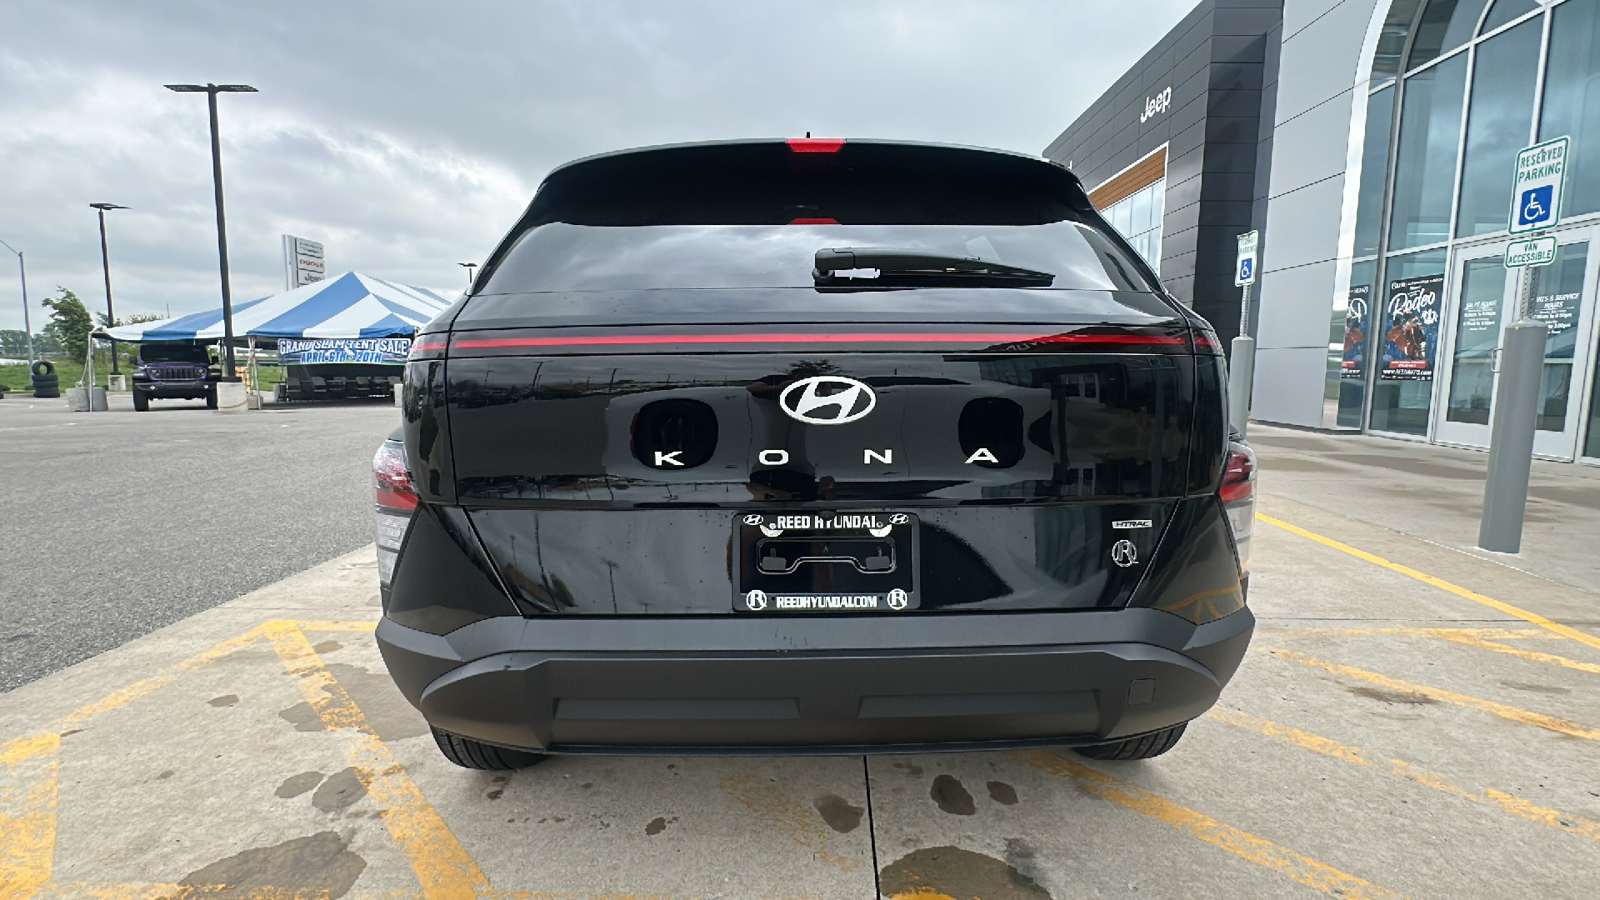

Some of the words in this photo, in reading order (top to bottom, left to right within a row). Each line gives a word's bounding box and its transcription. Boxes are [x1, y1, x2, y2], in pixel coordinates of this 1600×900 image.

[1140, 86, 1171, 123] Jeep
[1520, 146, 1563, 169] RESERVED
[1518, 161, 1562, 182] PARKING
[1524, 242, 1538, 252] VAN
[1507, 250, 1552, 264] ACCESSIBLE
[1388, 288, 1436, 320] Rodeo
[280, 340, 314, 355] GRAND
[314, 339, 345, 350] SLAM
[346, 339, 377, 351] TENT
[380, 339, 409, 356] SALE
[301, 351, 326, 363] APRIL
[355, 351, 383, 363] 20TH
[654, 447, 999, 466] KONA
[777, 515, 811, 530] REED
[776, 596, 878, 609] REEDHYUNDAI.COM
